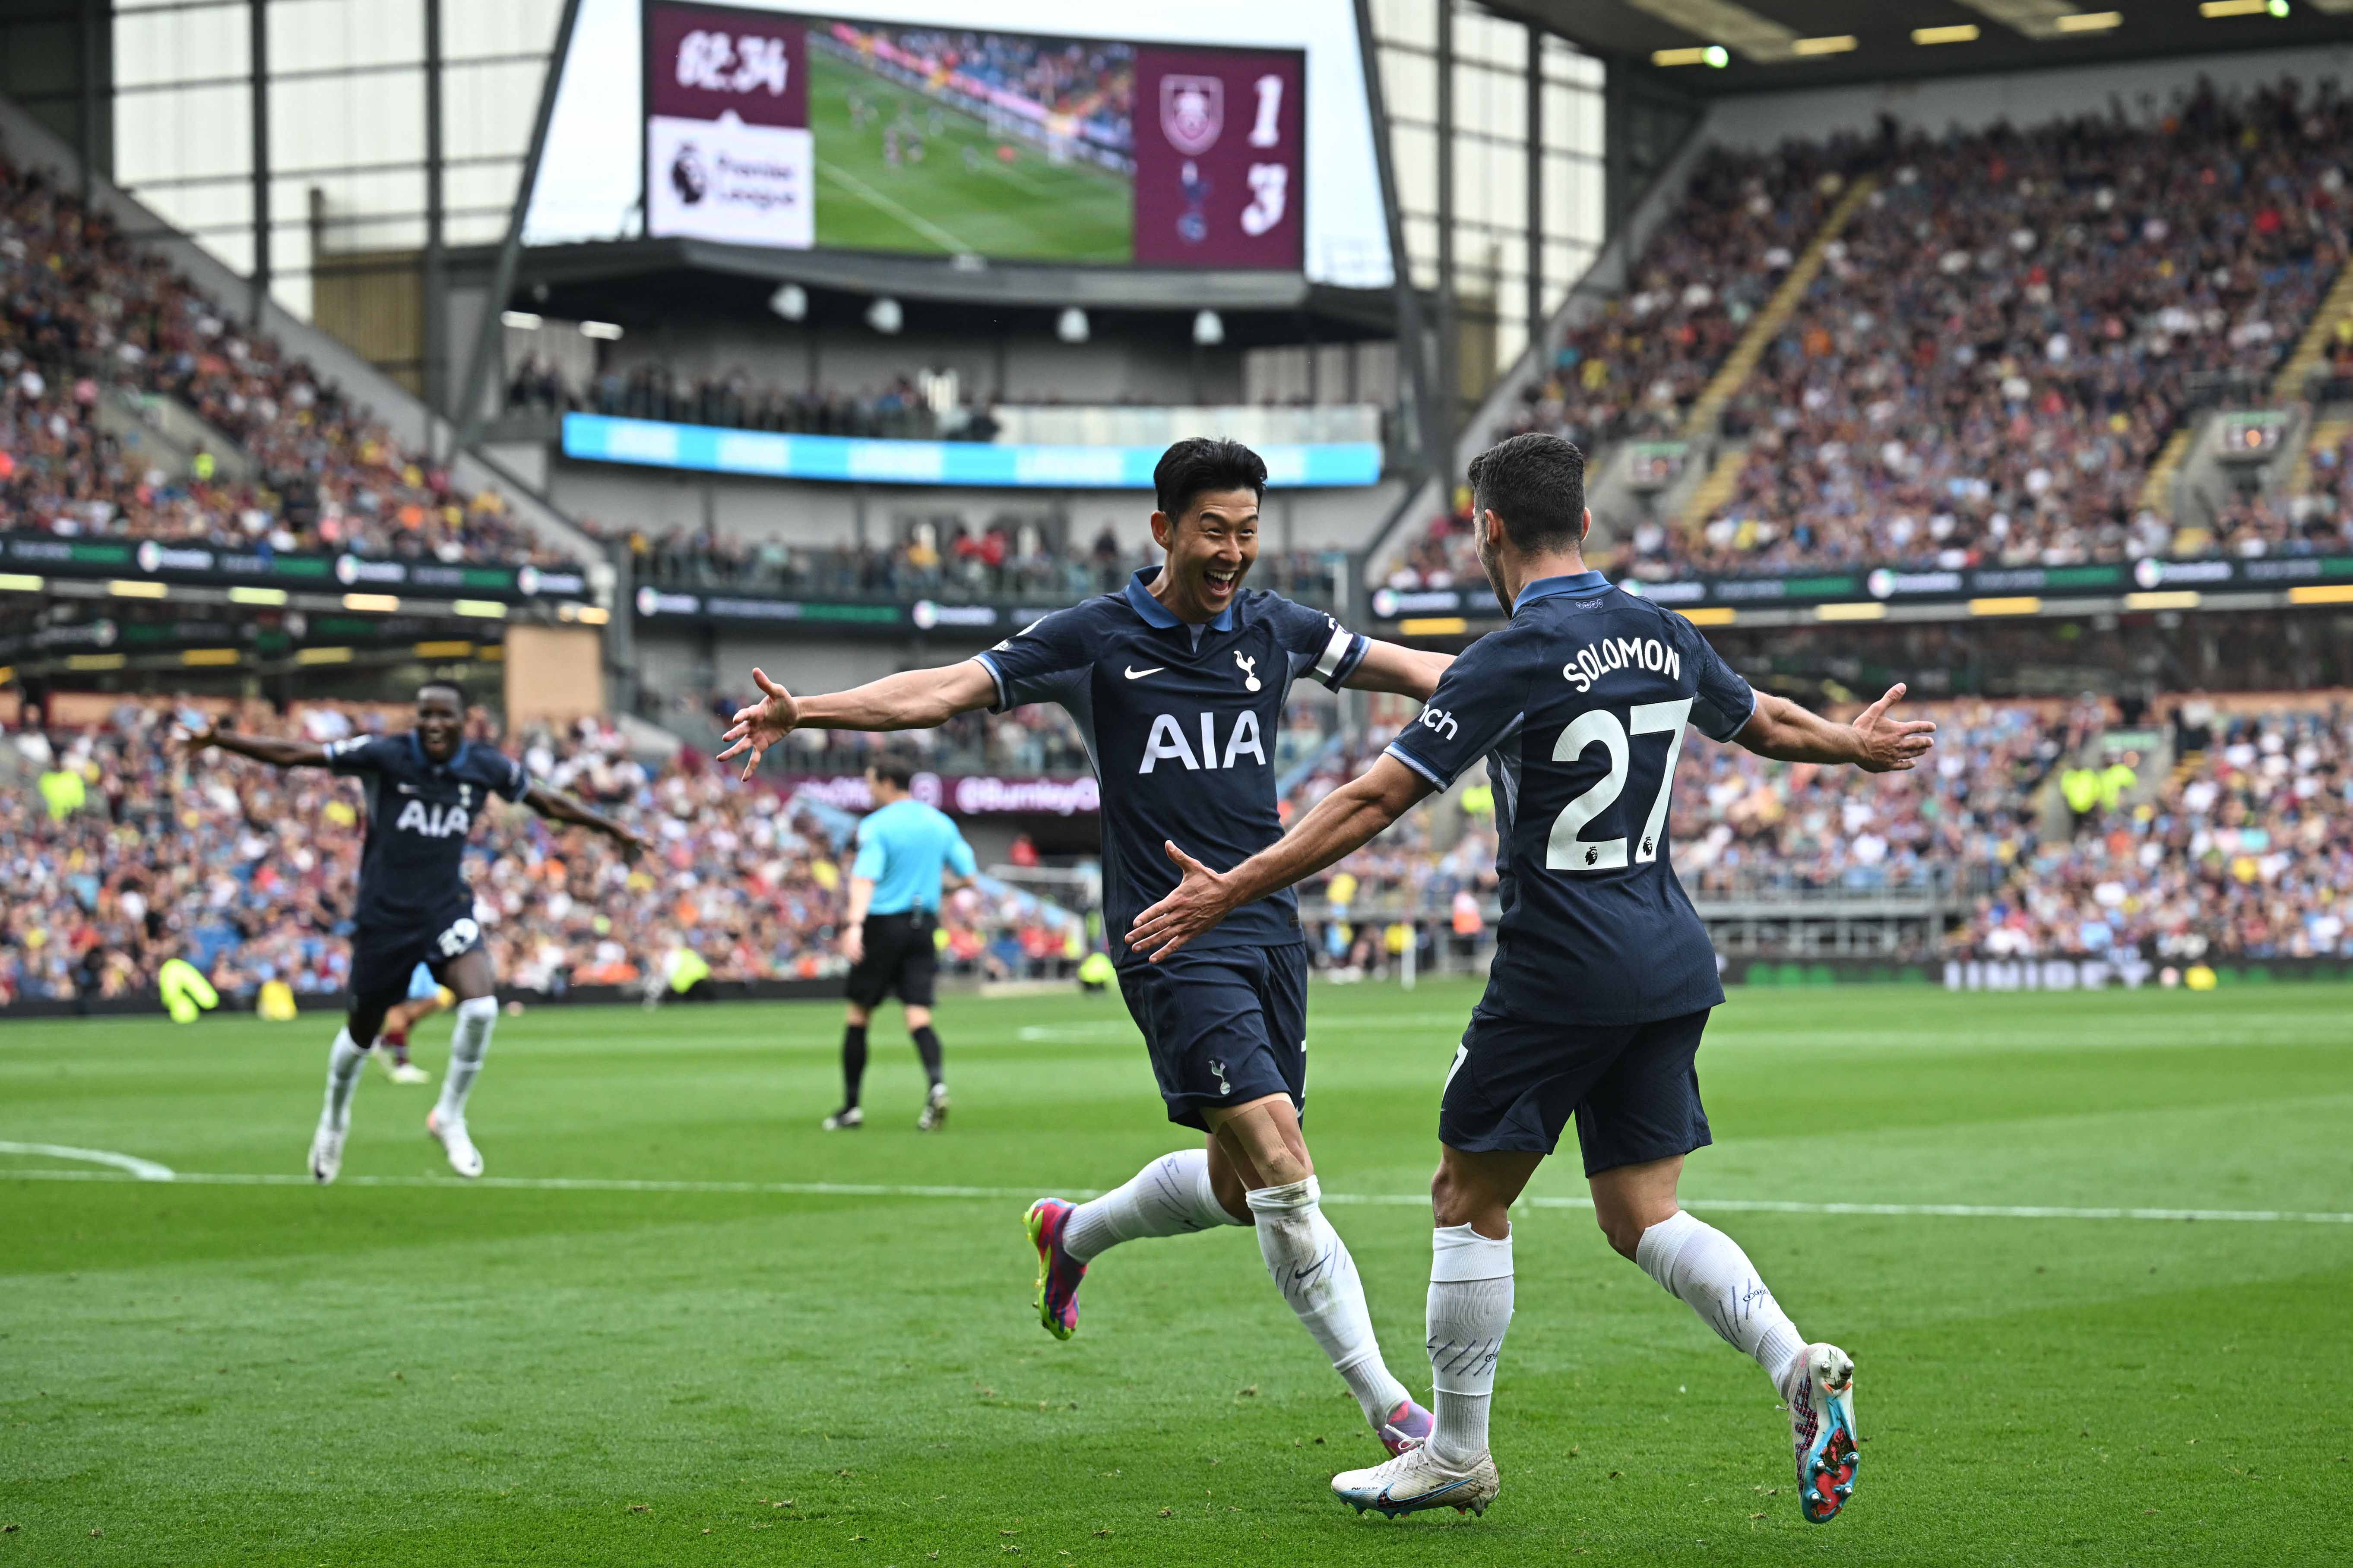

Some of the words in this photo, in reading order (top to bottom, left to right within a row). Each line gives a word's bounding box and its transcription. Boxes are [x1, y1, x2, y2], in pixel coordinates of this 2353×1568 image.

[1251, 75, 1283, 147] 1
[1241, 163, 1287, 235] 3
[1563, 637, 1680, 692] SOLOMON
[1139, 710, 1266, 774] AIA
[1546, 697, 1693, 870] 27
[396, 800, 469, 838] AIA
